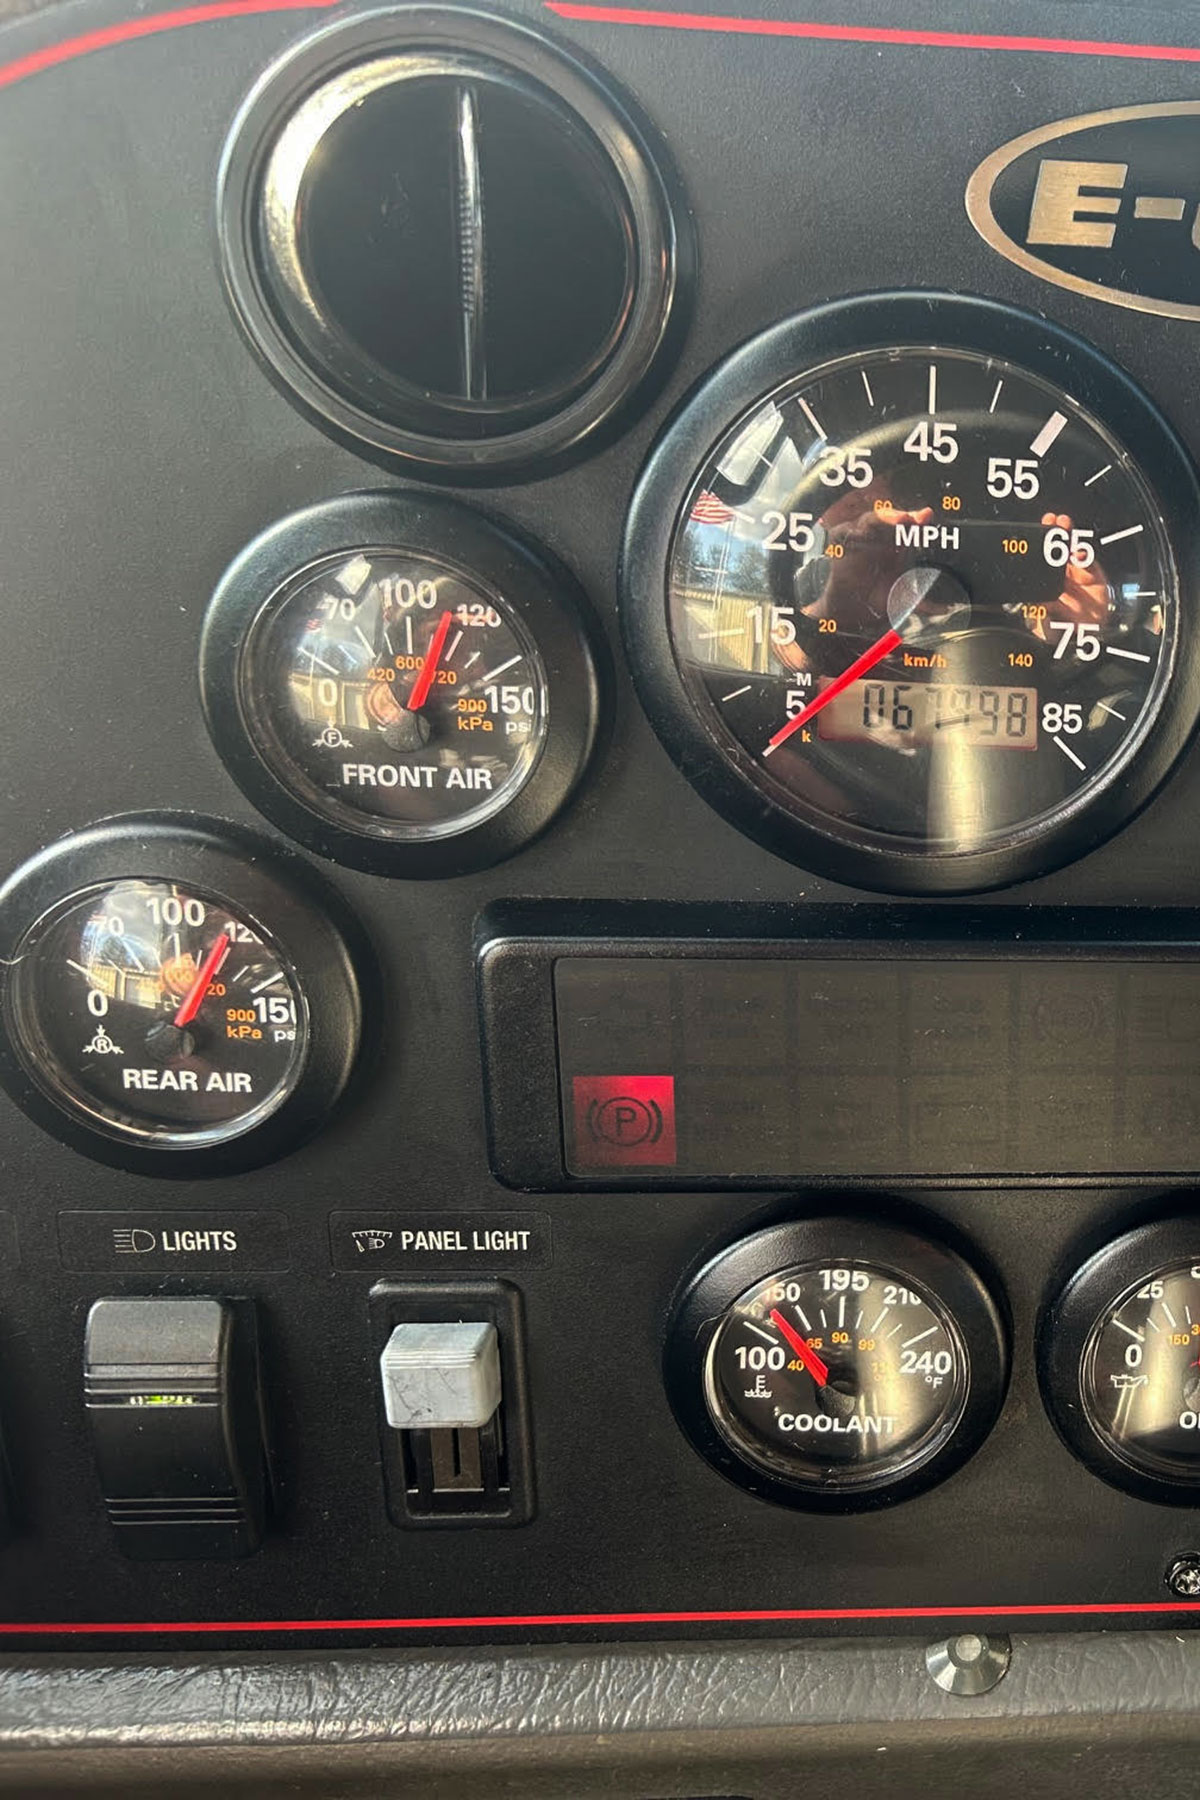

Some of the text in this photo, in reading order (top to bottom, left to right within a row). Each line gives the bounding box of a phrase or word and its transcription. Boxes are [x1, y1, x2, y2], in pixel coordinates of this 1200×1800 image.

[904, 423, 959, 463] 45
[819, 449, 873, 488] 35
[986, 458, 1039, 499] 55
[942, 497, 961, 510] 80
[762, 512, 814, 552] 25
[895, 524, 959, 549] MPH
[825, 545, 844, 558] 40
[1002, 540, 1028, 553] 100
[1043, 528, 1095, 567] 65
[379, 579, 437, 608] 100
[324, 595, 356, 620] 70
[457, 603, 501, 627] 120
[1021, 606, 1047, 619] 120
[750, 607, 796, 646] 15
[818, 619, 837, 633] 20
[1050, 622, 1101, 661] 75
[395, 655, 425, 670] 600
[903, 652, 947, 668] km/h
[1008, 654, 1033, 667] 140
[368, 667, 395, 682] 420
[797, 672, 812, 687] M
[319, 680, 337, 707] 0
[485, 685, 534, 715] 150
[457, 700, 487, 713] 900
[786, 690, 806, 721] 5
[457, 717, 493, 732] kPa
[1042, 703, 1083, 732] 85
[802, 729, 812, 743] k
[342, 764, 493, 789] FRONT AIR
[146, 898, 205, 926] 100
[225, 921, 263, 944] 12
[207, 984, 226, 996] 20
[87, 990, 109, 1017] 0
[226, 1010, 256, 1022] 900
[226, 1026, 262, 1039] kPa
[274, 1029, 296, 1042] ps
[123, 1069, 252, 1093] REAR AIR
[616, 1107, 638, 1136] P
[162, 1231, 237, 1252] LIGHTS
[401, 1230, 531, 1252] PANEL LIGHT
[818, 1269, 870, 1291] 195
[1136, 1281, 1164, 1299] 25
[806, 1338, 823, 1349] 65
[831, 1332, 848, 1343] 90
[858, 1339, 875, 1351] 99
[1169, 1334, 1190, 1345] 150
[735, 1346, 785, 1371] 100
[787, 1360, 804, 1371] 40
[899, 1350, 952, 1374] 240
[1125, 1344, 1143, 1368] 0
[777, 1413, 898, 1433] COOLANT
